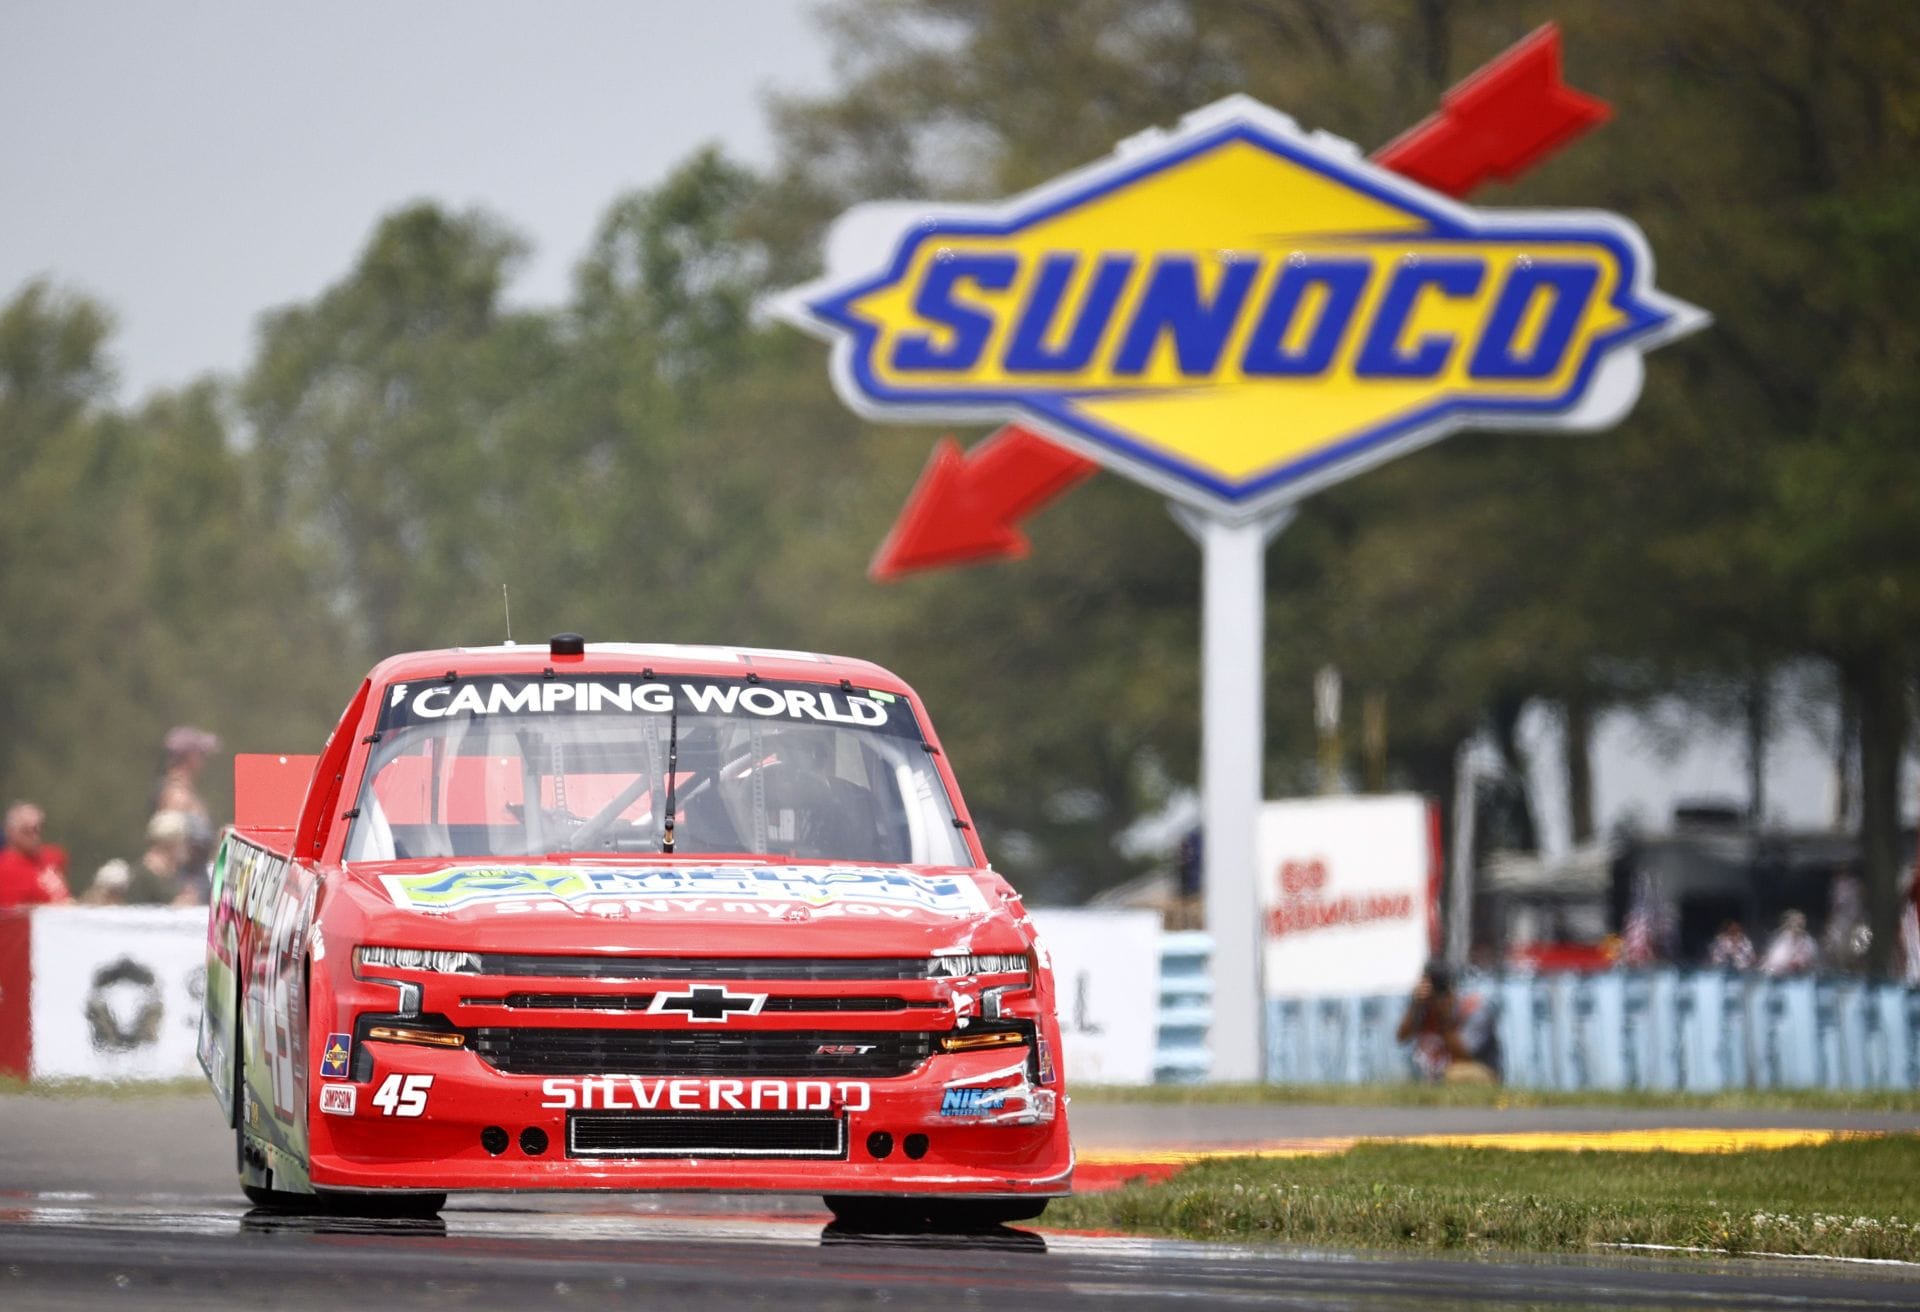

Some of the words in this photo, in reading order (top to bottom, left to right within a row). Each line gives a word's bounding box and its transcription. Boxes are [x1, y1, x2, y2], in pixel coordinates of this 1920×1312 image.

[890, 252, 1601, 378] SUNOCO
[412, 683, 674, 718] CAMPING
[681, 684, 888, 726] WORLD
[815, 1044, 877, 1055] RST
[324, 1089, 352, 1110] SIMPSON
[372, 1074, 435, 1118] 45
[542, 1078, 870, 1111] SILVERADO
